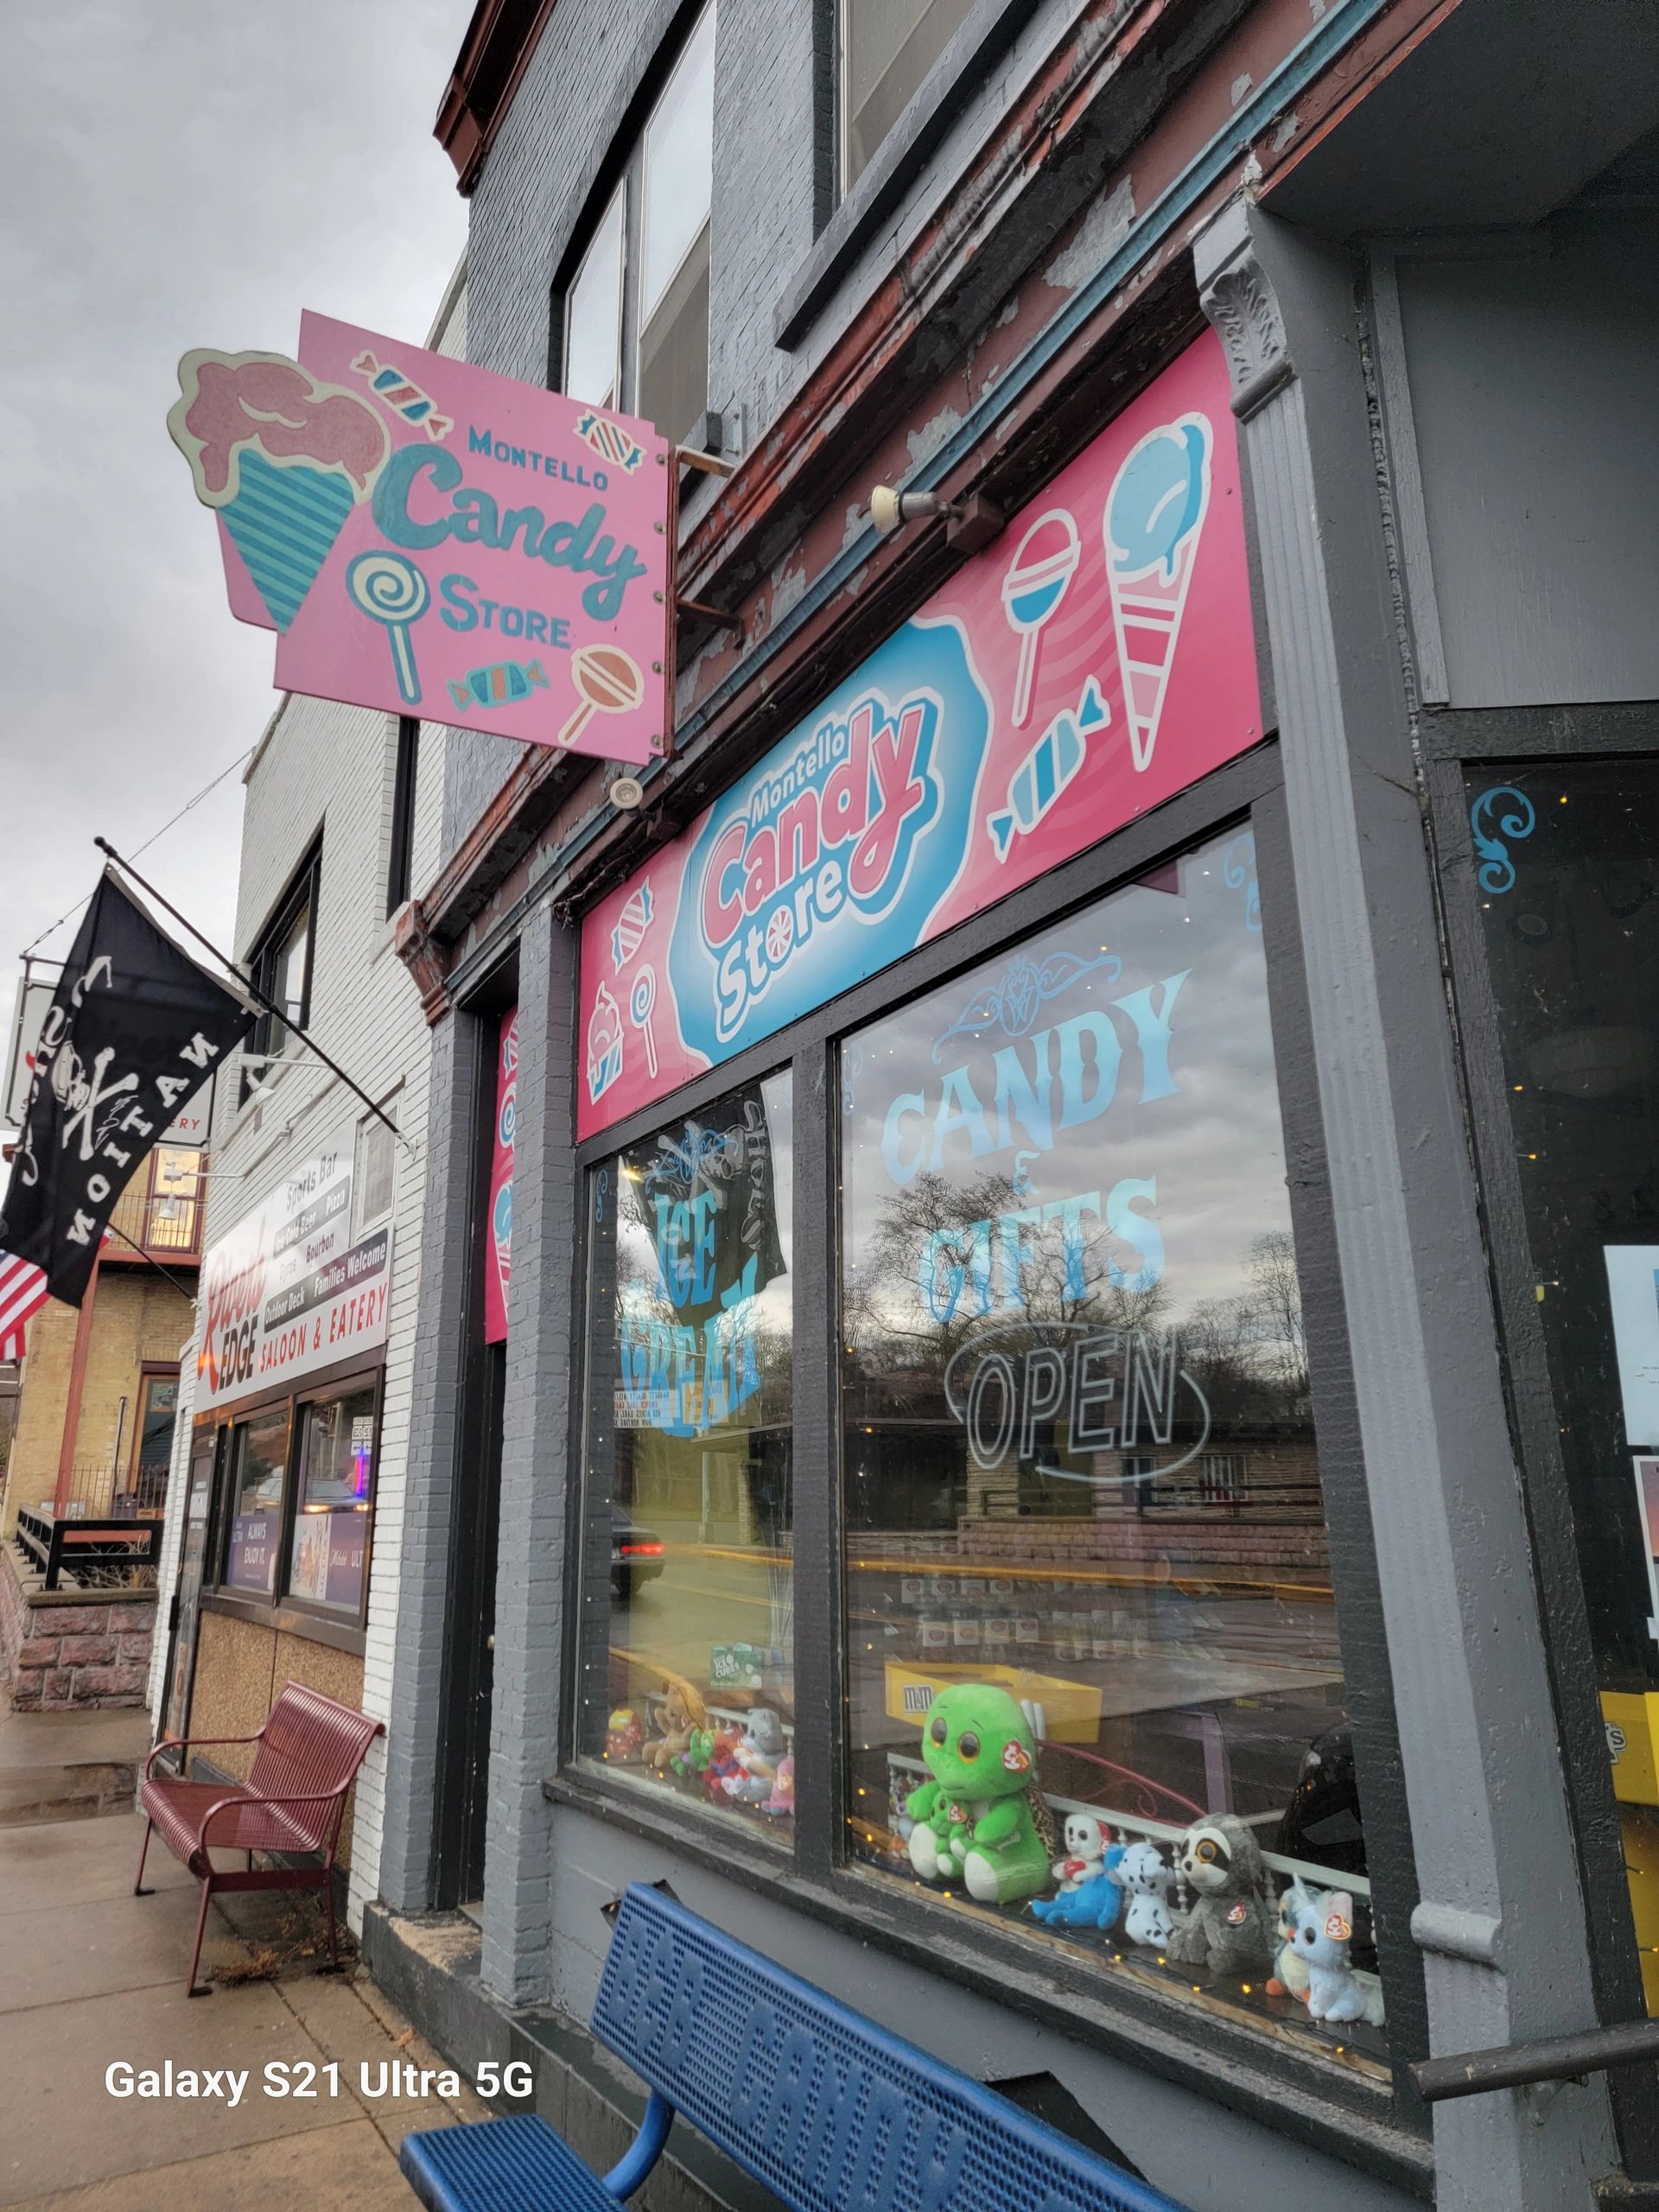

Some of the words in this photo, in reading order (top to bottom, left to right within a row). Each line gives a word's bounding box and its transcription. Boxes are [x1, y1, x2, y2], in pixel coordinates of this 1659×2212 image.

[469, 424, 609, 492] MONTELLO
[372, 442, 647, 621] Candy
[439, 573, 573, 650] STORE
[703, 703, 924, 945] Candy
[749, 730, 846, 830] Montello
[719, 861, 843, 1036] Store
[880, 969, 1193, 1185] CANDY
[285, 1168, 316, 1215] Sports
[319, 1150, 338, 1185] Bar
[325, 1188, 346, 1217] Pizza
[264, 1299, 289, 1325] Outdoor
[287, 1285, 306, 1313] Deck
[313, 1264, 346, 1299] Families
[346, 1242, 387, 1281] Welcome
[305, 1231, 335, 1264] Bourbon
[653, 1188, 719, 1309] ICE
[918, 1174, 1166, 1324] GIFTS
[218, 1313, 259, 1392] EDGE
[259, 1323, 308, 1375] SALOON
[313, 1315, 322, 1351] &
[328, 1281, 388, 1344] EATERY
[967, 1329, 1179, 1469] OPEN
[714, 1658, 728, 1672] ICE
[715, 1661, 741, 1679] CUBES
